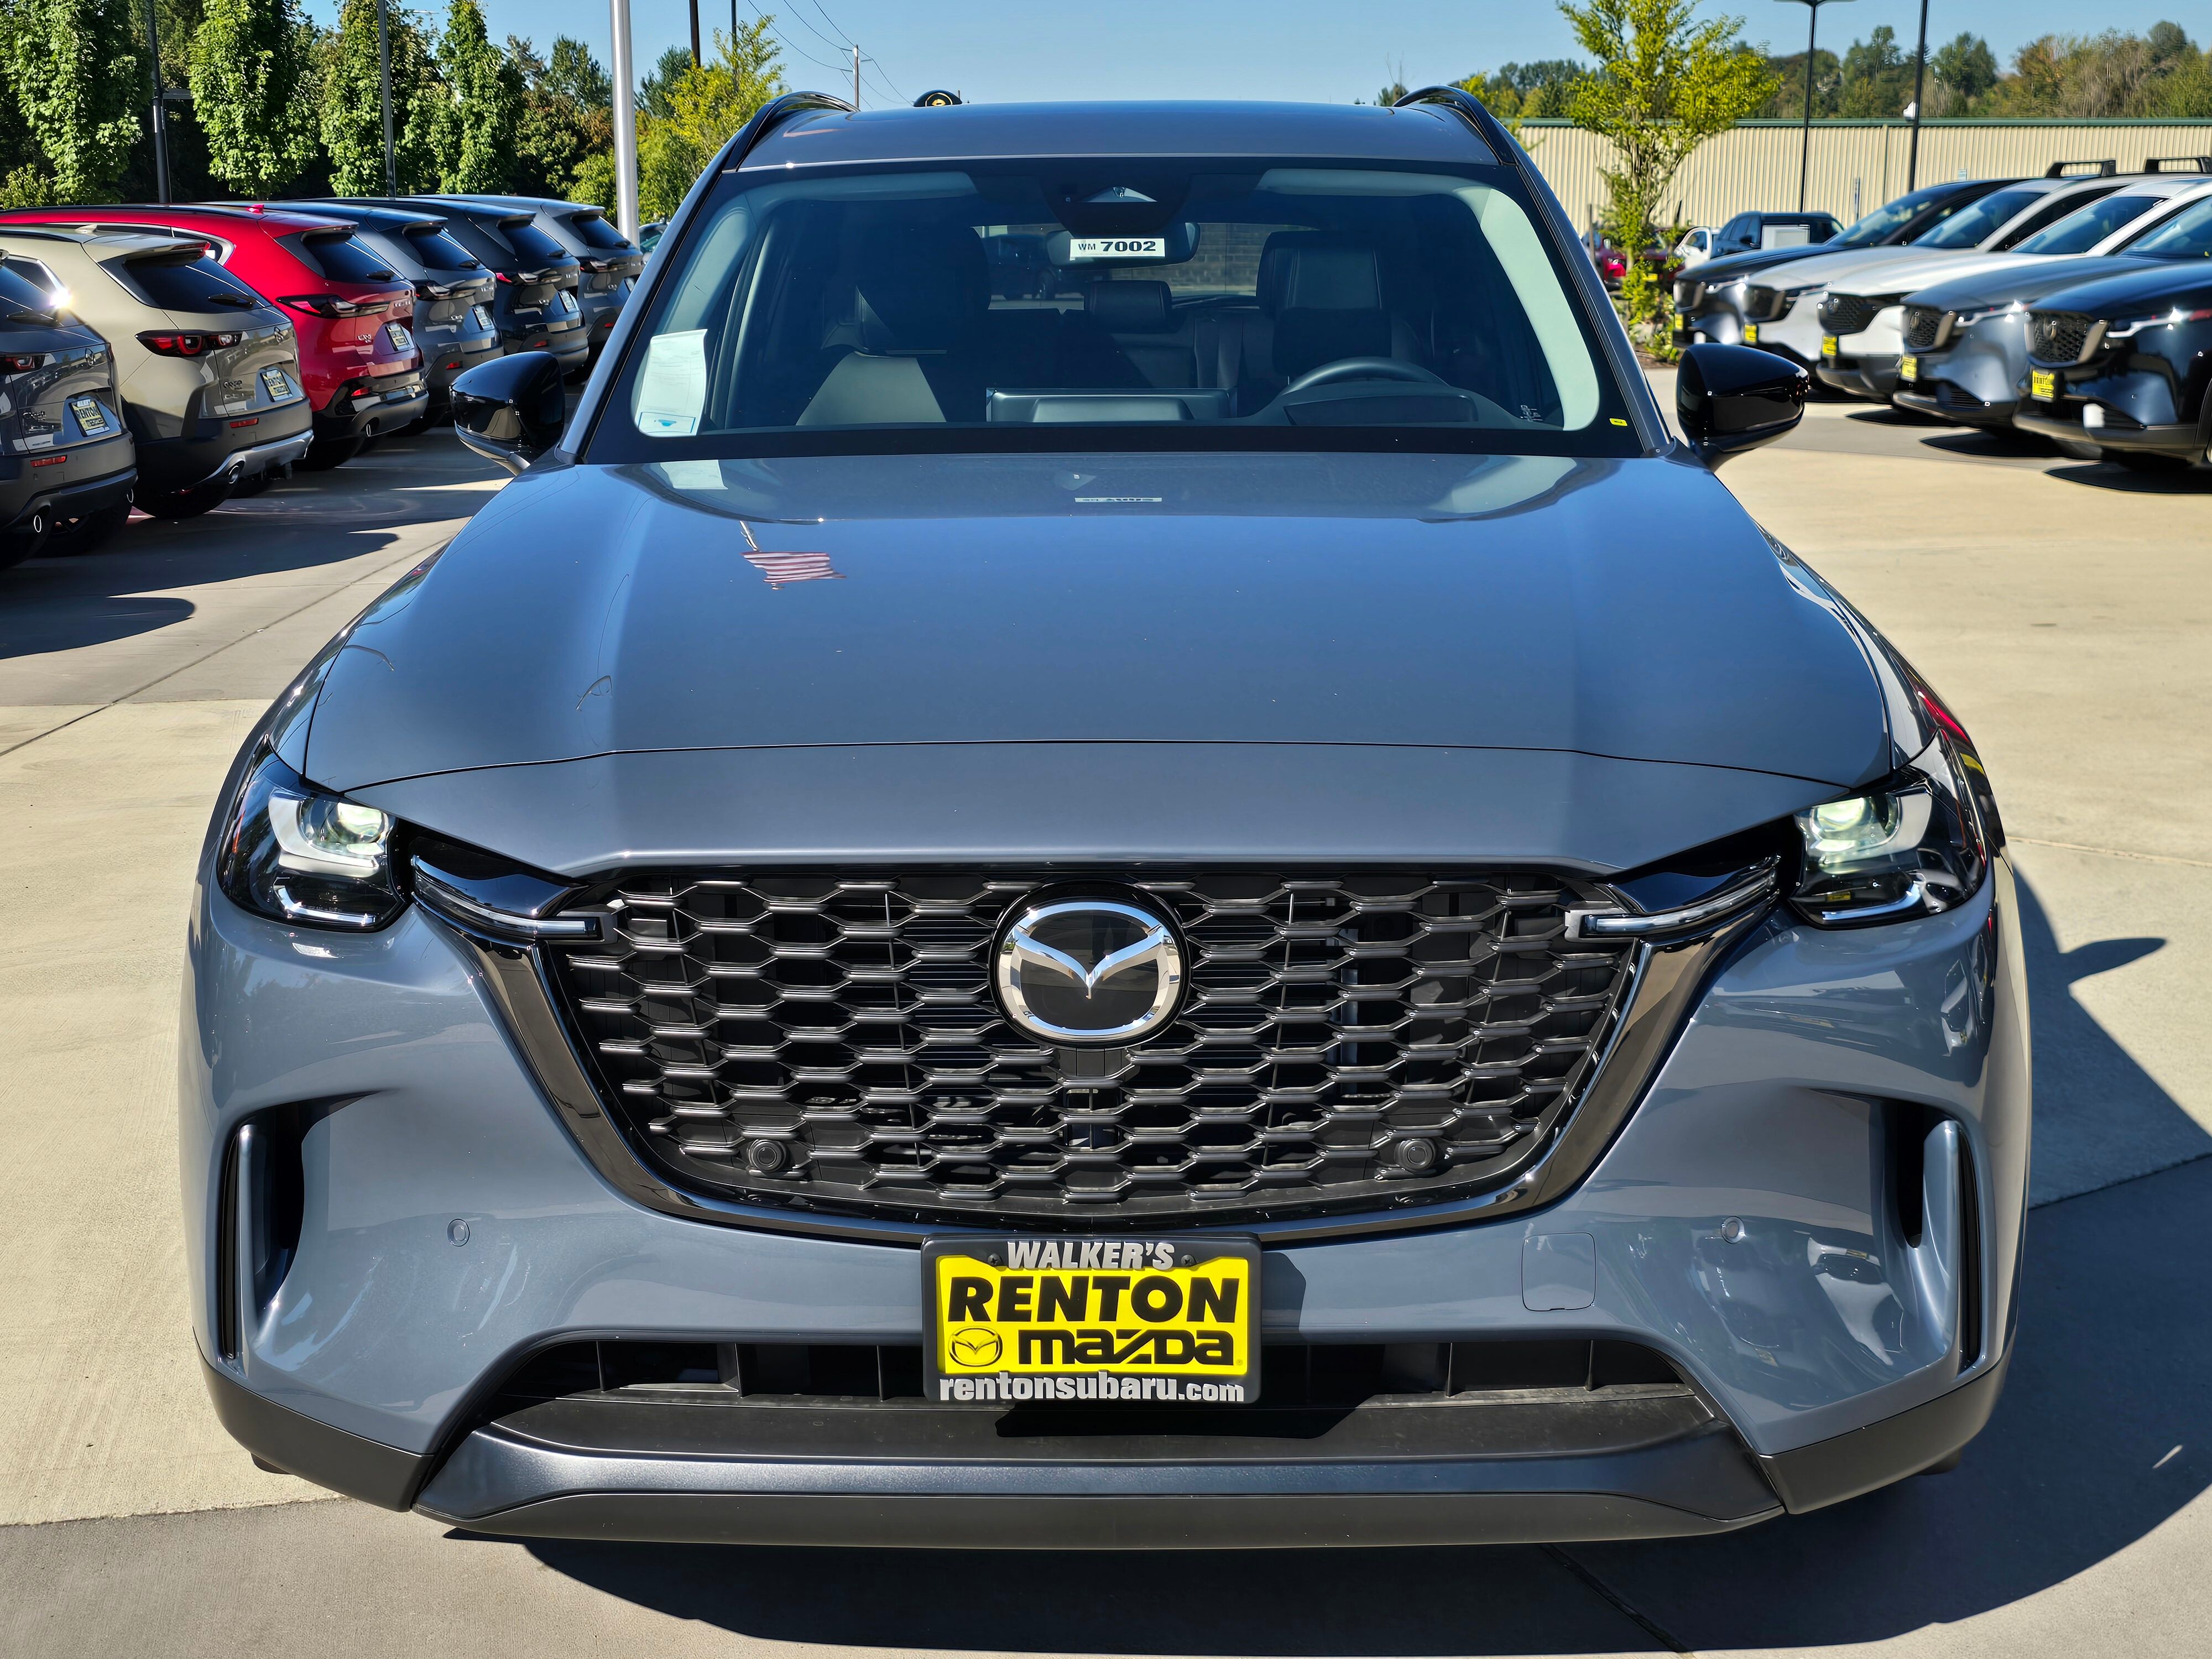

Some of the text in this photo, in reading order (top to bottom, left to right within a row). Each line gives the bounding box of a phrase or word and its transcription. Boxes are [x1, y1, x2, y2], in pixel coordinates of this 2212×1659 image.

[1100, 241, 1156, 252] 7002
[1008, 1241, 1175, 1270] WALKER'S
[948, 1276, 1240, 1323] RENTON
[940, 1370, 1244, 1402] rentonsubaru.com
